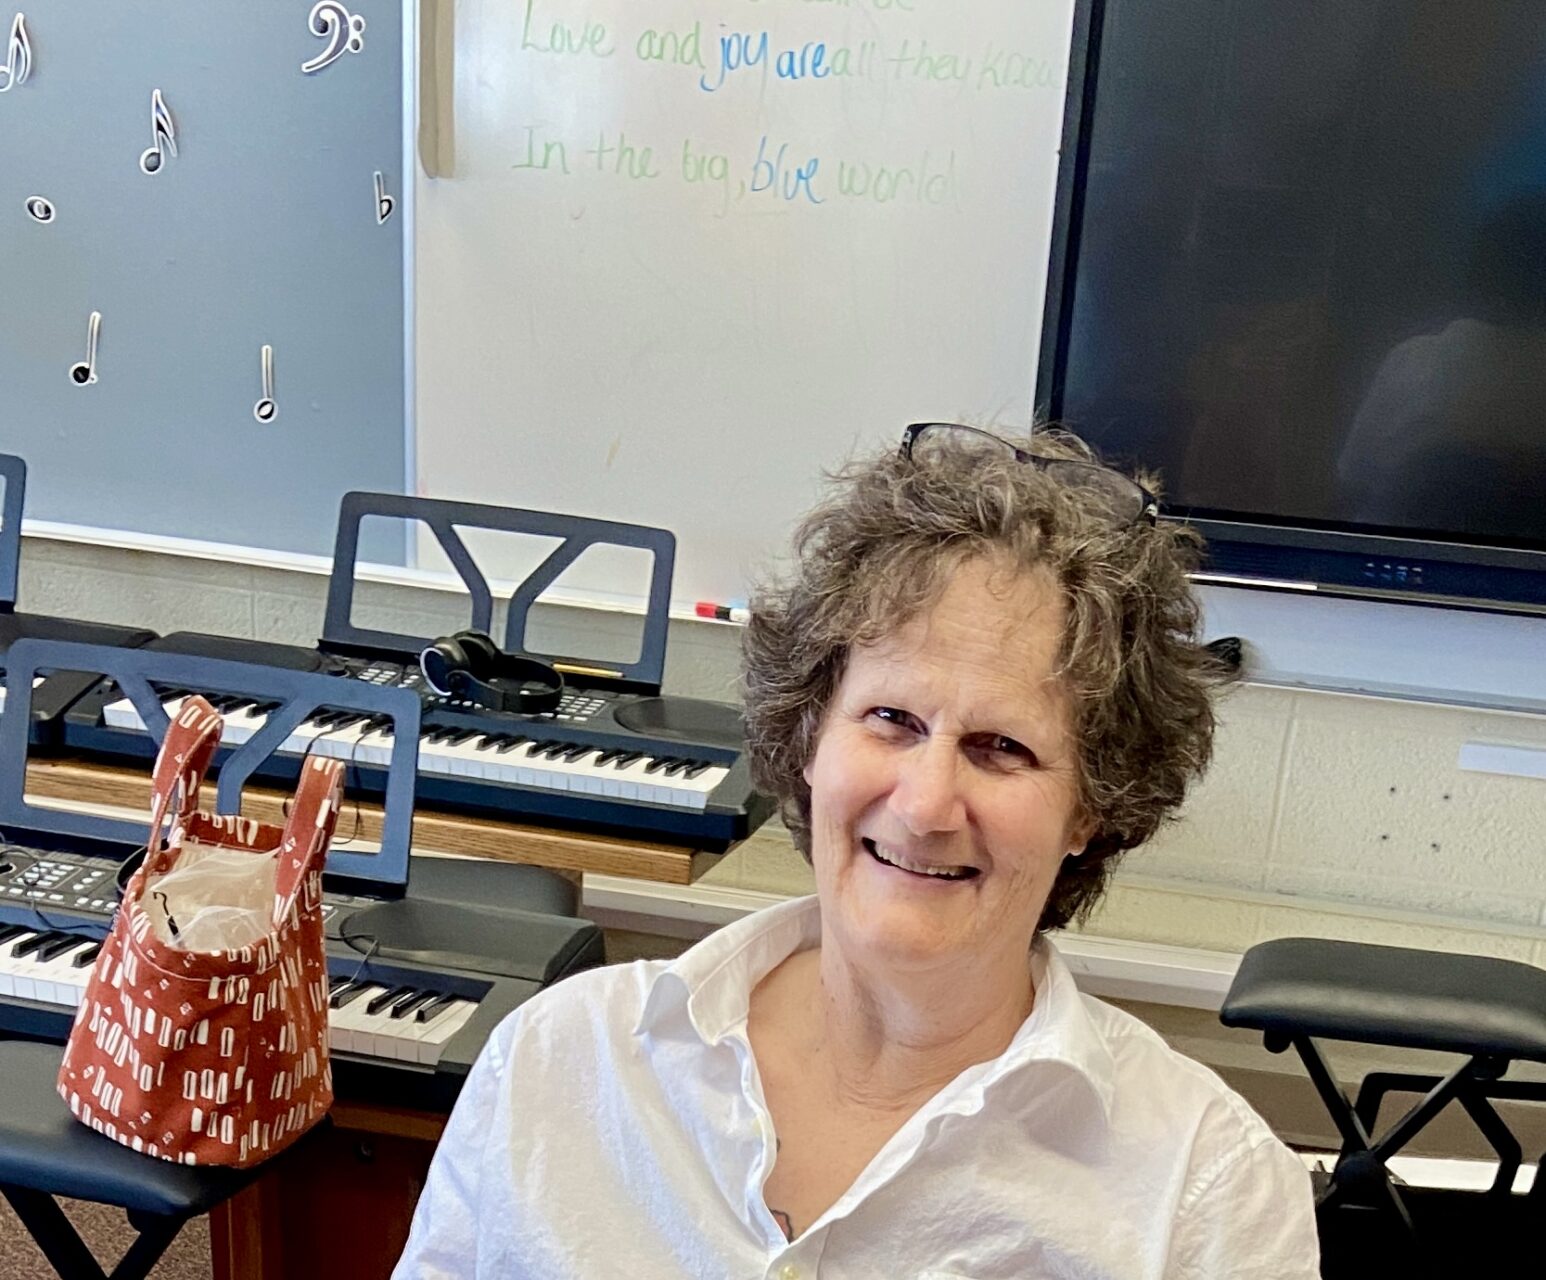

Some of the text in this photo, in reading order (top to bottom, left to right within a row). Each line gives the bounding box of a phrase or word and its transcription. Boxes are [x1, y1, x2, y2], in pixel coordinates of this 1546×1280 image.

[520, 0, 615, 57] Love
[635, 21, 707, 69] and
[699, 24, 769, 98] joy
[775, 42, 831, 80] are
[830, 41, 877, 82] all
[886, 39, 972, 101] they
[511, 125, 571, 175] In
[585, 131, 659, 179] the
[750, 135, 827, 204] blue
[837, 150, 962, 213] world
